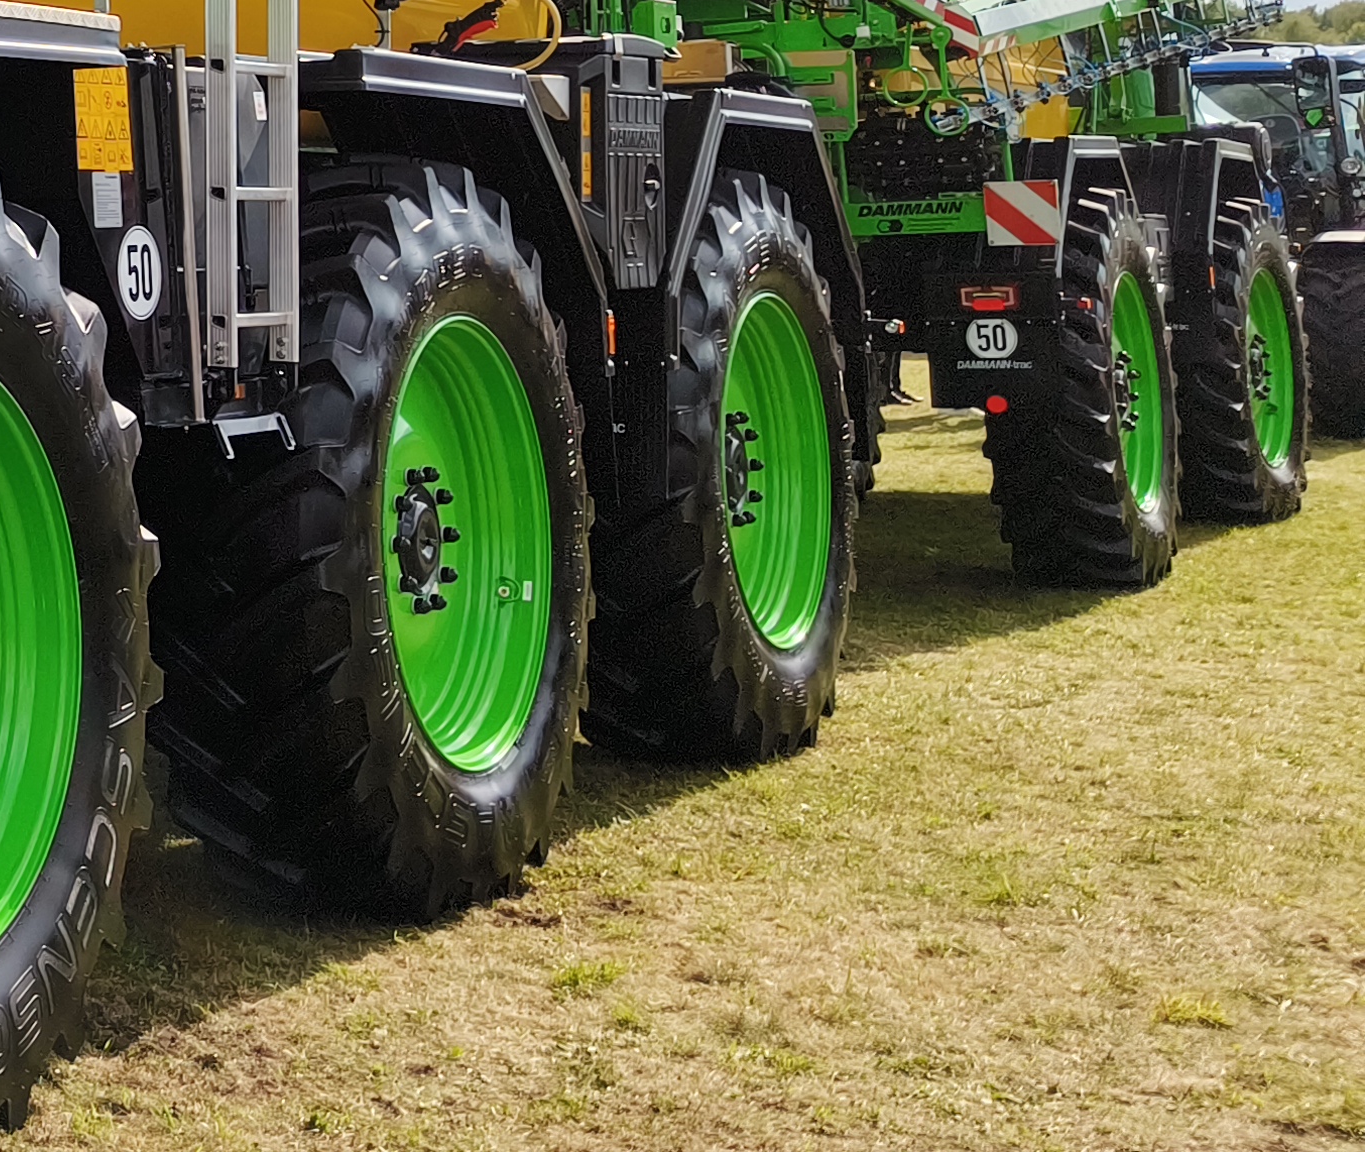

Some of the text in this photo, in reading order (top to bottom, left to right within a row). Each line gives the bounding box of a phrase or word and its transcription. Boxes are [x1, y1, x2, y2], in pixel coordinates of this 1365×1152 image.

[857, 201, 964, 218] DAMMANN
[127, 243, 153, 302] 50
[976, 324, 1007, 352] 50
[956, 359, 1033, 370] DAMMANN-trac
